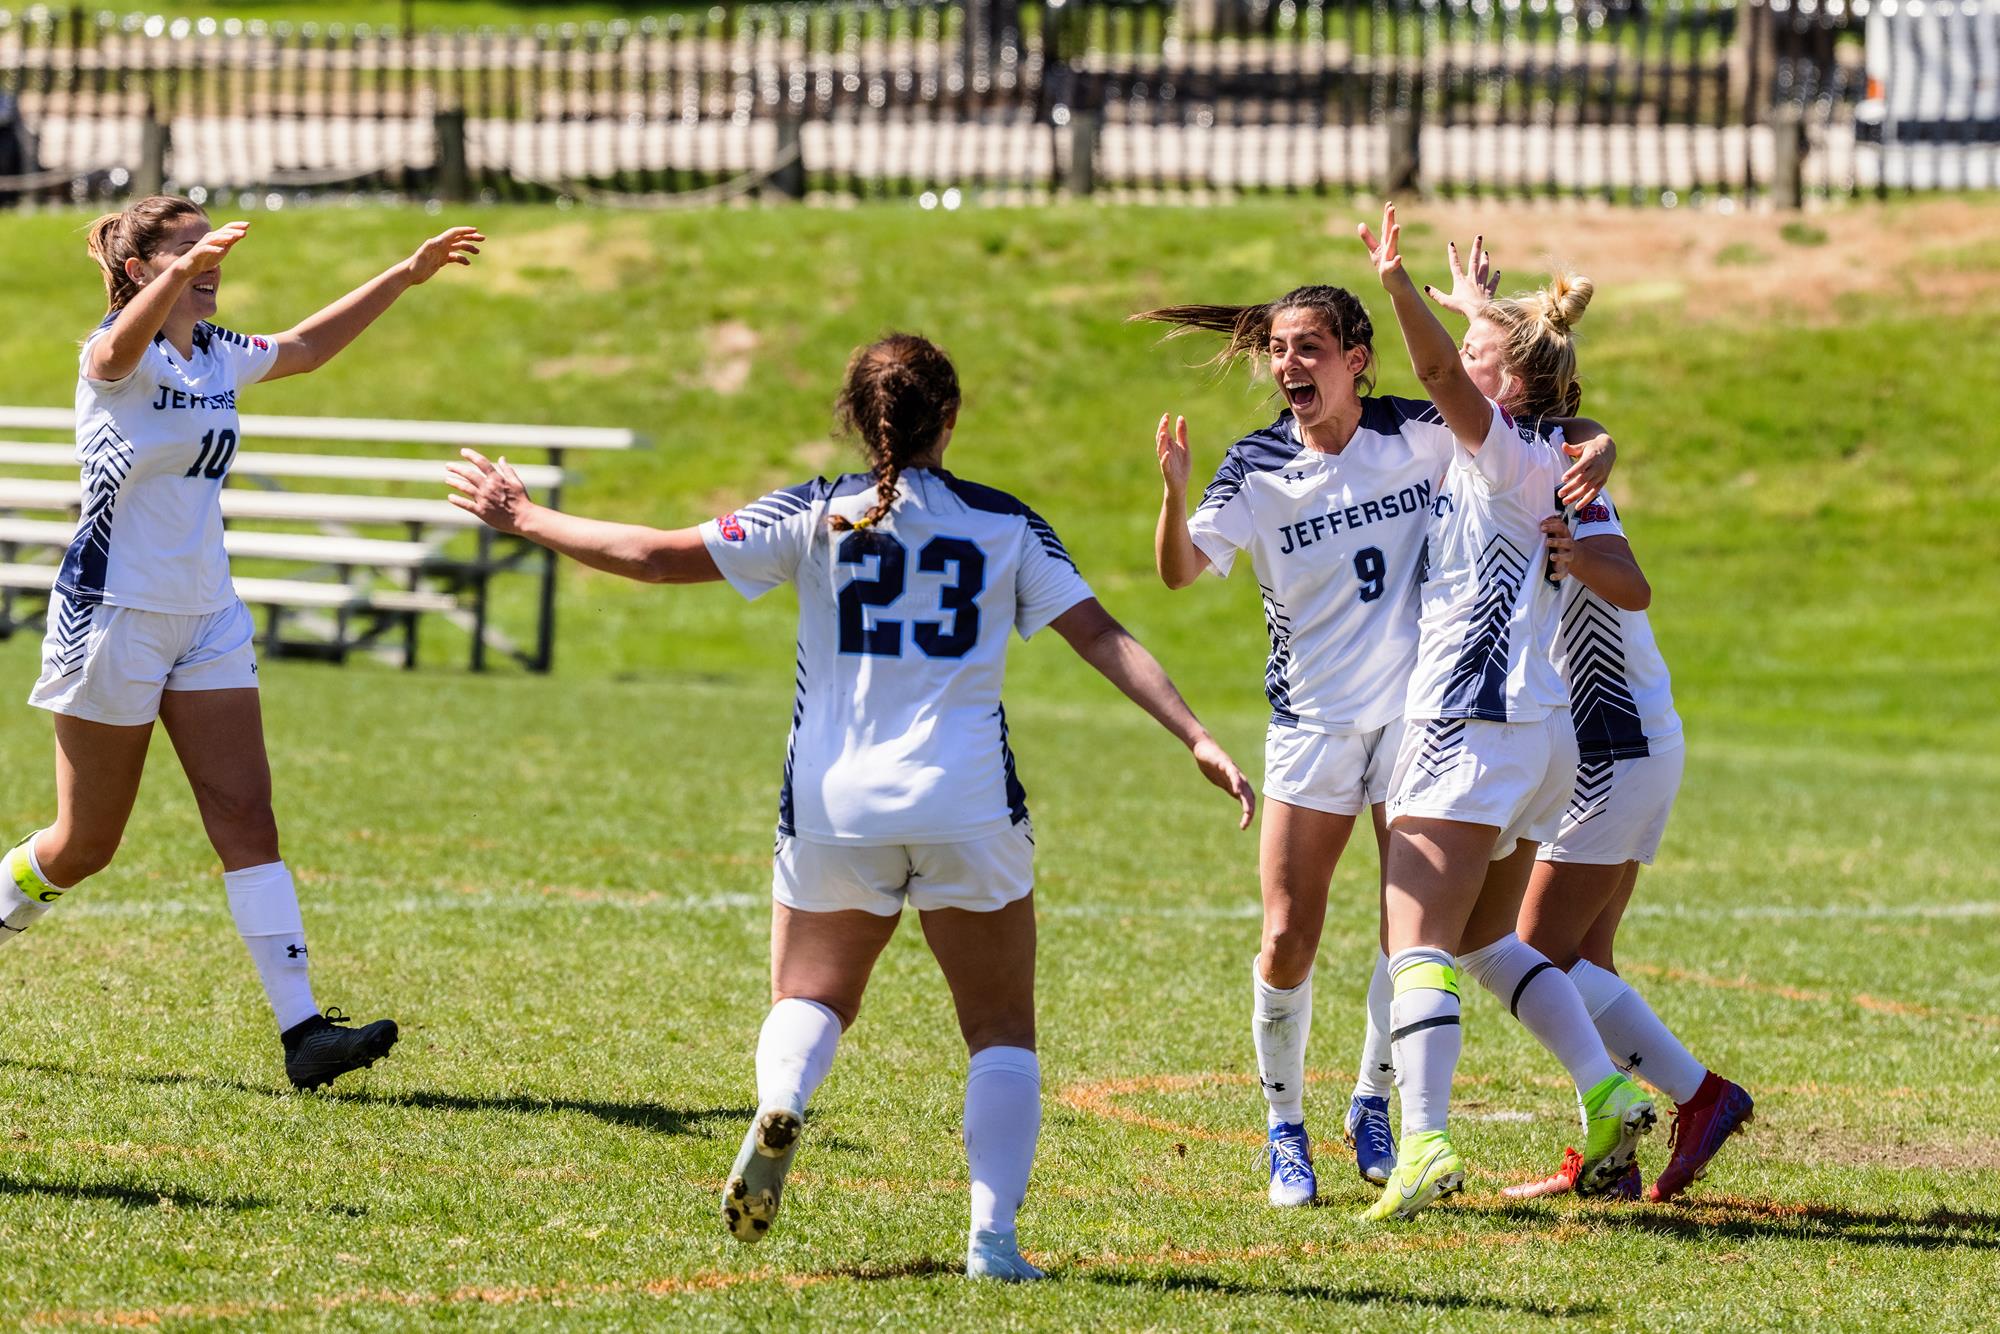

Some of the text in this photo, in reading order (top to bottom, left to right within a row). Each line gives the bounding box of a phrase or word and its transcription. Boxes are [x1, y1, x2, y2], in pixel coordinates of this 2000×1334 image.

[184, 428, 236, 479] 10
[1278, 479, 1431, 555] JEFFERSON
[837, 531, 988, 660] 23
[1353, 546, 1387, 603] 9
